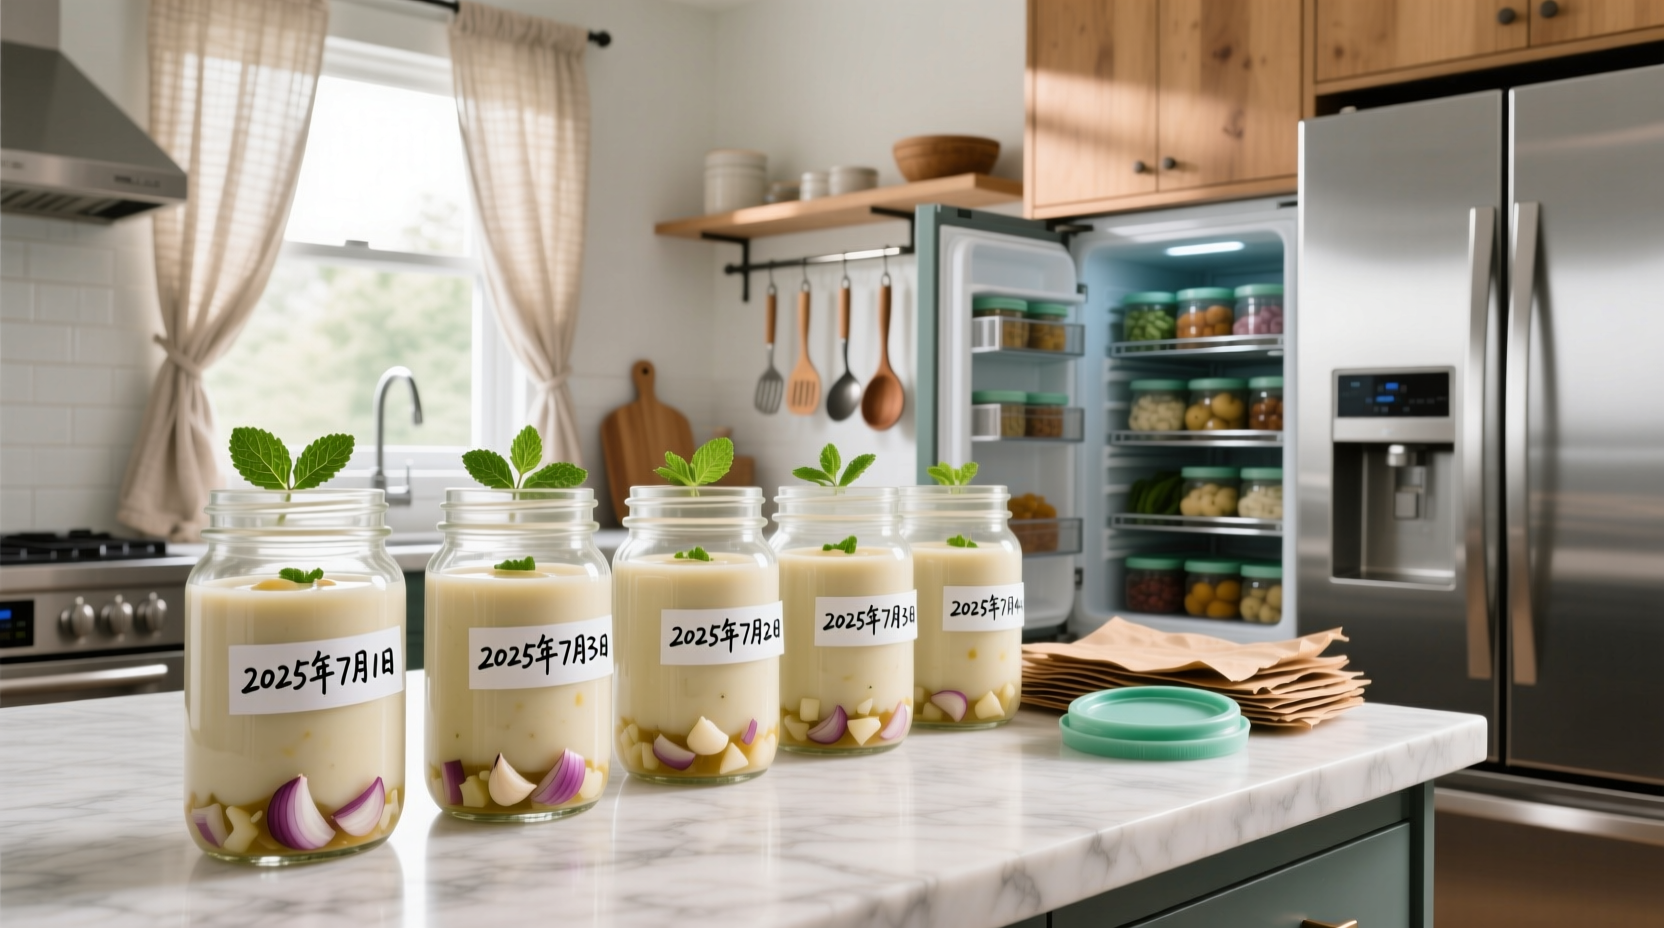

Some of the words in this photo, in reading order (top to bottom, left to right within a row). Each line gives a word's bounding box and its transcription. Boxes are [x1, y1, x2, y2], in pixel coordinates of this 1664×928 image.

[669, 618, 780, 653] 2025年7月2日
[823, 604, 915, 635] 2025年7月3日
[241, 647, 394, 695] 2025年7月1日
[478, 633, 608, 675] 2025年7月3日
